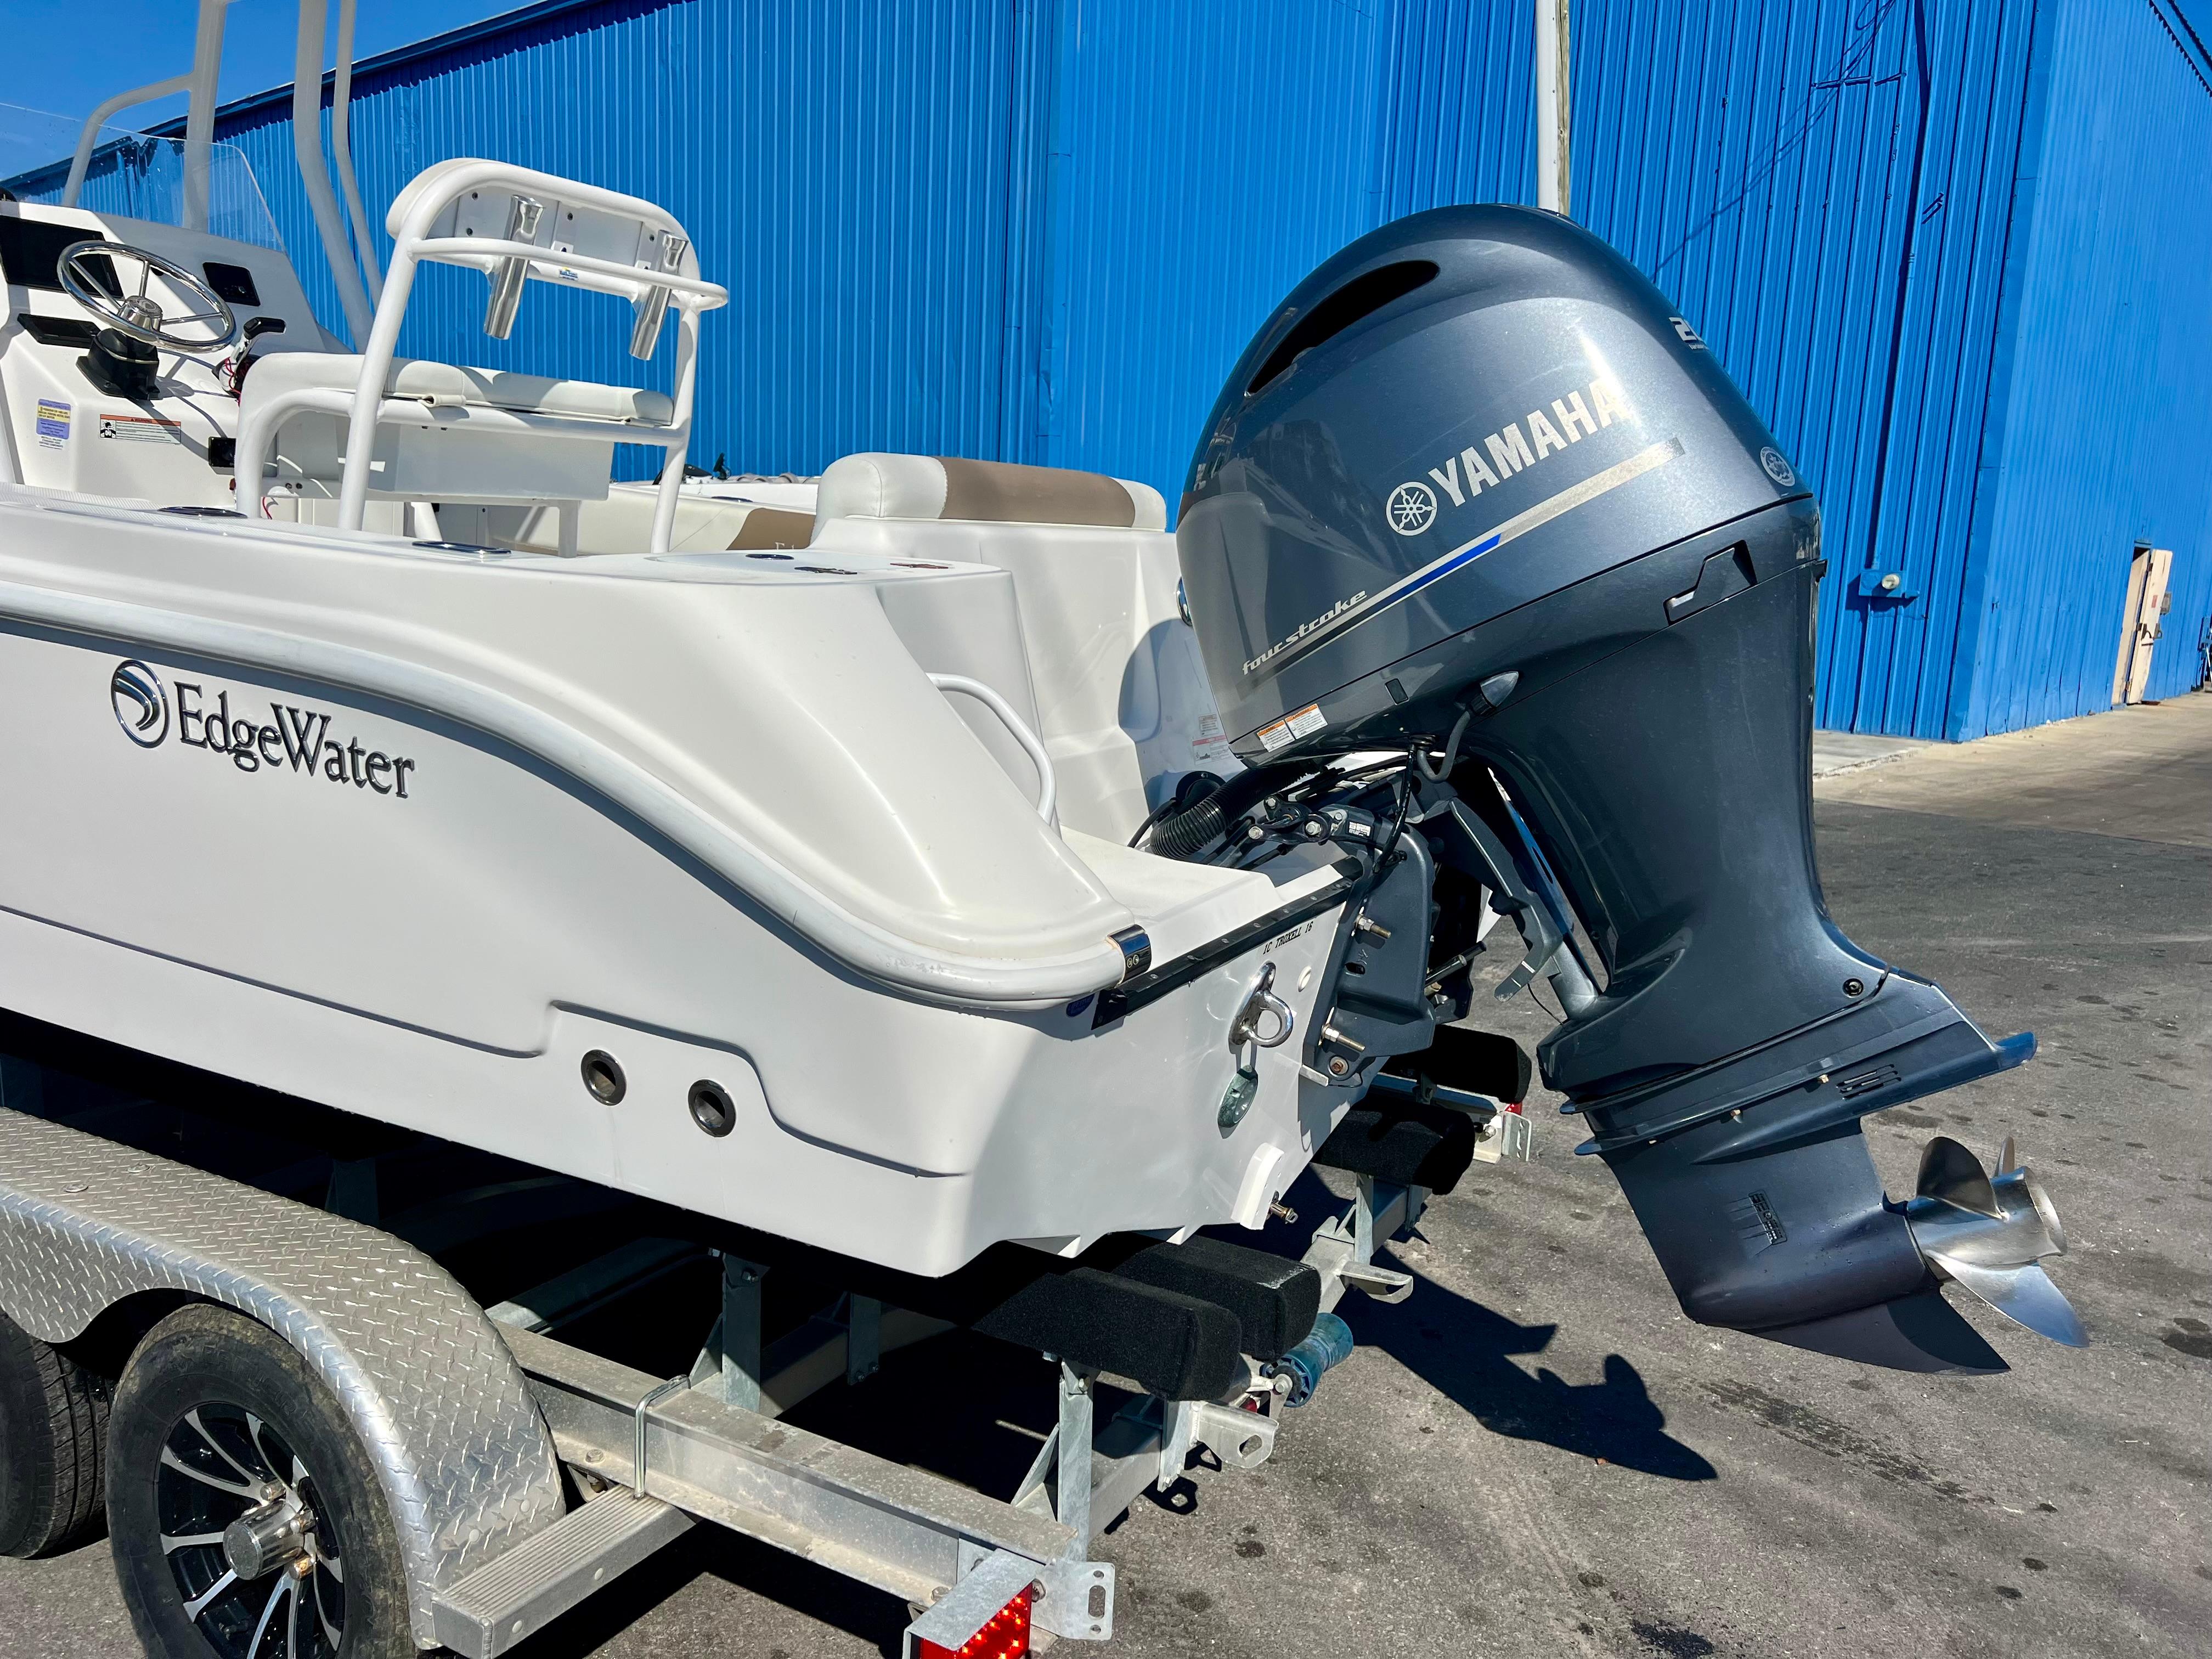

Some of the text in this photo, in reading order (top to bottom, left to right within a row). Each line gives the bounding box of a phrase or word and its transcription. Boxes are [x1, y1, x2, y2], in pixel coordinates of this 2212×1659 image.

[1668, 317, 1703, 341] 2
[1428, 378, 1634, 506] YAMAHA
[174, 681, 415, 799] EdgeWater
[1275, 927, 1302, 949] TROXELL
[1305, 921, 1313, 933] 16
